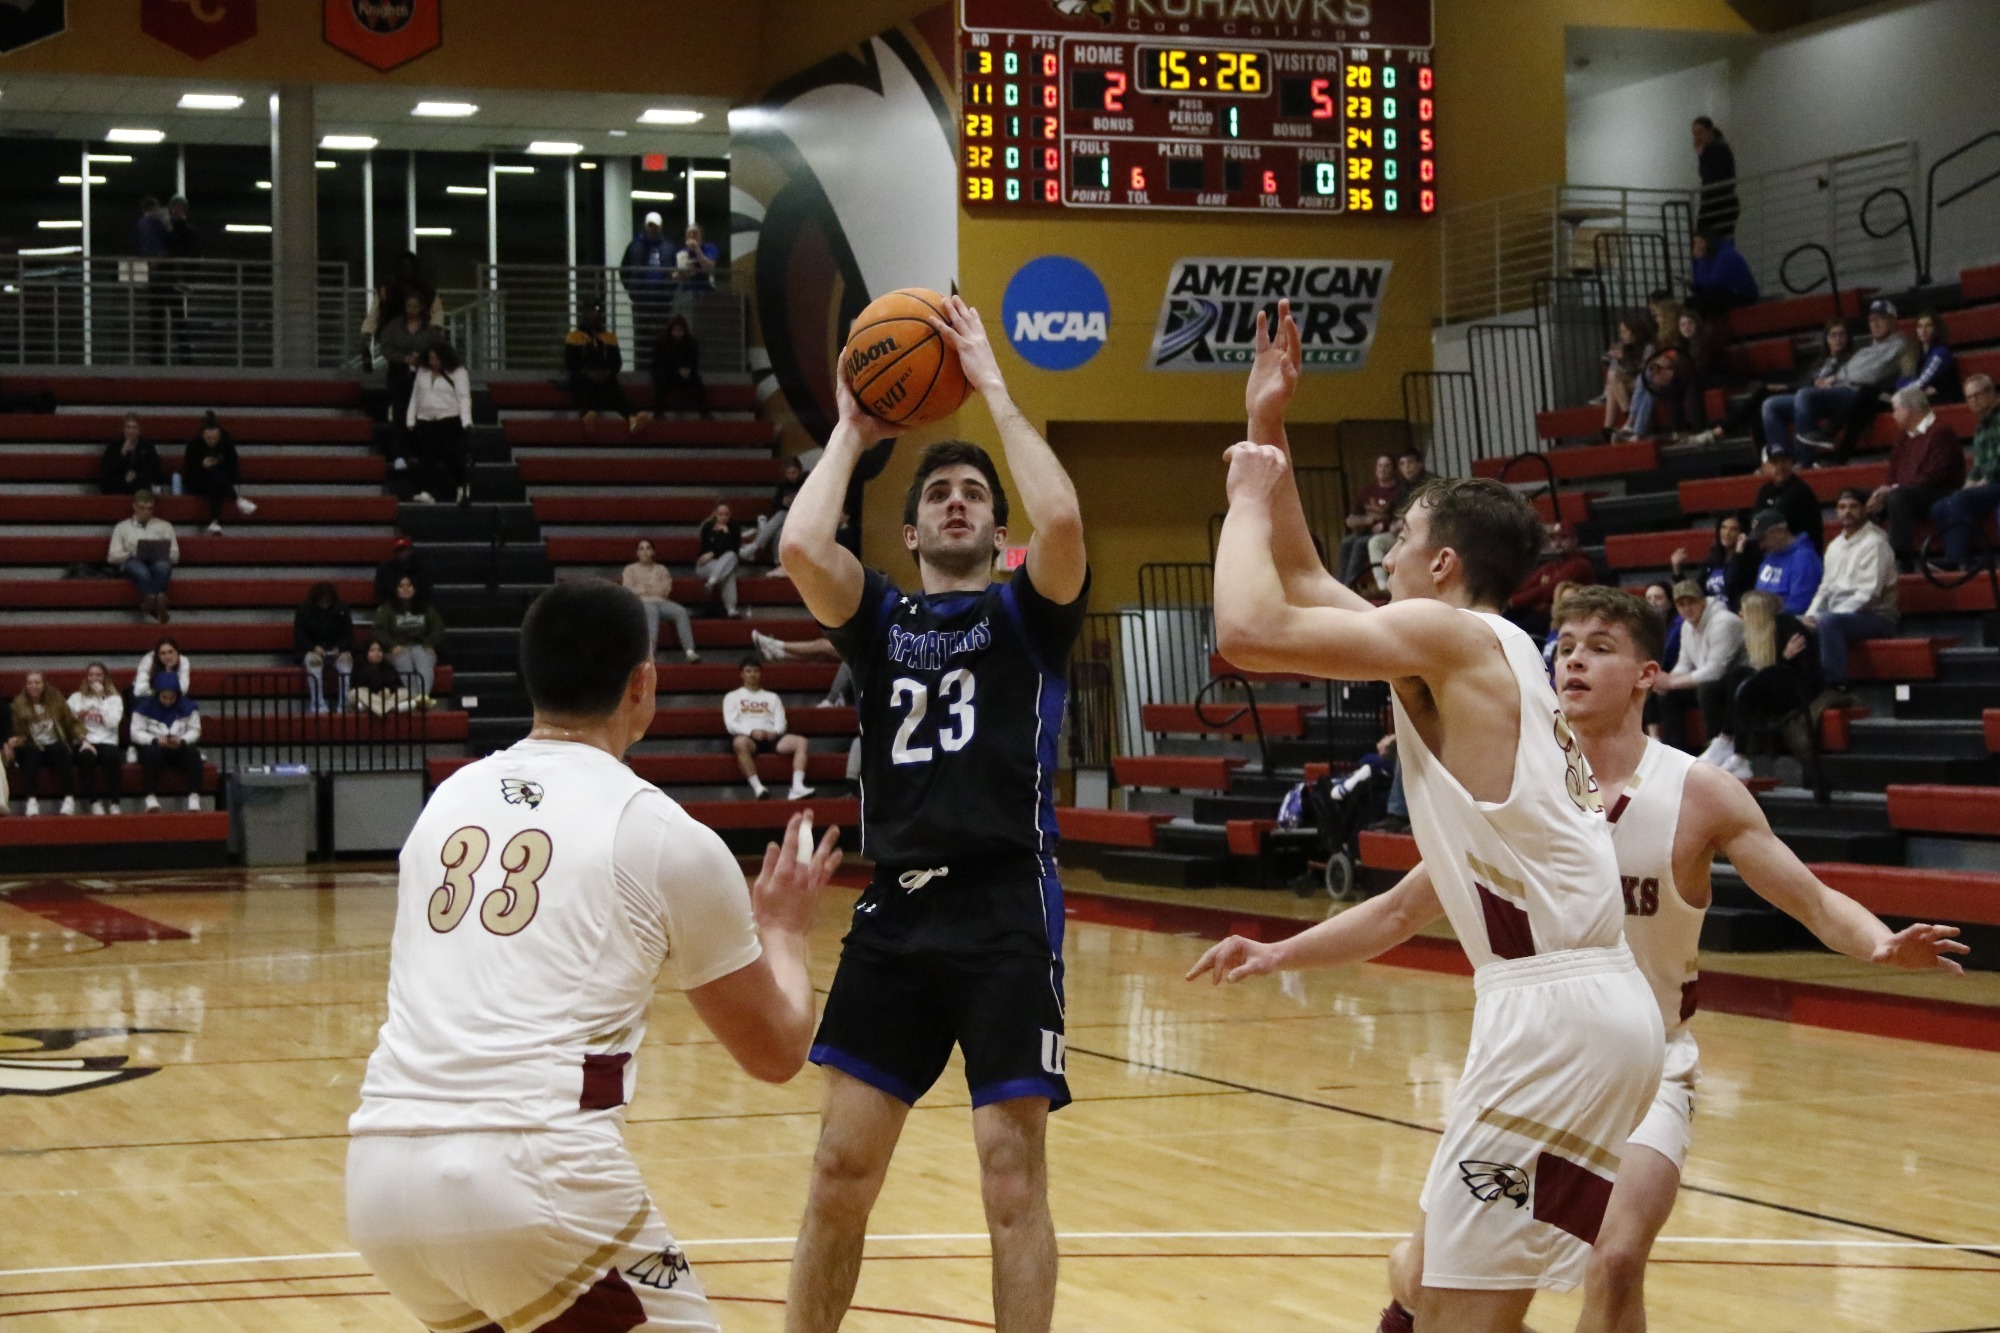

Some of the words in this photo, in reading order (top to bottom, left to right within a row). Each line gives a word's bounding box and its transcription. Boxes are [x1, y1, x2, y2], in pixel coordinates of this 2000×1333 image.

[972, 33, 990, 47] NO
[1007, 34, 1015, 48] F
[1032, 36, 1056, 49] PTS
[978, 51, 992, 74] 3
[1004, 52, 1018, 75] 0
[1043, 53, 1057, 77] 0
[1074, 45, 1124, 65] HOME
[1273, 52, 1338, 73] VISITOR
[1408, 51, 1431, 64] PTS
[1159, 50, 1261, 92] 15:26
[1346, 65, 1372, 88] 20
[1383, 66, 1396, 89] 0
[1419, 67, 1433, 91] 0
[972, 83, 993, 104] 11
[1004, 83, 1018, 106] 0
[1043, 85, 1057, 108] 0
[1104, 71, 1127, 111] 2
[1311, 79, 1333, 118] 5
[1168, 110, 1214, 125] PERIOD
[1346, 96, 1372, 119] 23
[1383, 97, 1397, 120] 0
[1419, 98, 1433, 121] 0
[966, 114, 993, 137] 23
[1012, 116, 1019, 137] 1
[1044, 116, 1058, 139] 2
[1093, 117, 1134, 132] BONUS
[1229, 106, 1239, 137] 1
[1273, 123, 1312, 137] BONUS
[1071, 140, 1110, 155] FOULS
[1347, 127, 1373, 148] 24
[1384, 128, 1397, 150] 0
[1419, 129, 1433, 151] 5
[966, 146, 993, 168] 32
[1005, 147, 1019, 169] 0
[1044, 148, 1058, 171] 0
[1158, 143, 1204, 158] PLAYER
[1223, 145, 1261, 160] FOULS
[1298, 148, 1336, 162] FOULS
[1101, 156, 1109, 188] 1
[1131, 167, 1145, 189] 6
[1262, 170, 1277, 193] 6
[1316, 162, 1335, 195] 0
[1348, 158, 1373, 180] 32
[1384, 159, 1397, 180] 0
[1420, 159, 1434, 182] 0
[966, 177, 994, 200] 33
[1005, 178, 1020, 200] 0
[1044, 178, 1059, 202] 0
[1071, 189, 1111, 203] POINTS
[1127, 190, 1150, 204] TOL
[1196, 193, 1228, 206] GAME
[1259, 193, 1281, 208] TOL
[1348, 188, 1373, 211] 35
[1384, 189, 1398, 211] 0
[1420, 189, 1434, 212] 0
[1172, 263, 1383, 298] AMERICAN
[1013, 311, 1108, 343] NCAA
[889, 668, 976, 765] 23
[427, 825, 554, 937] 33
